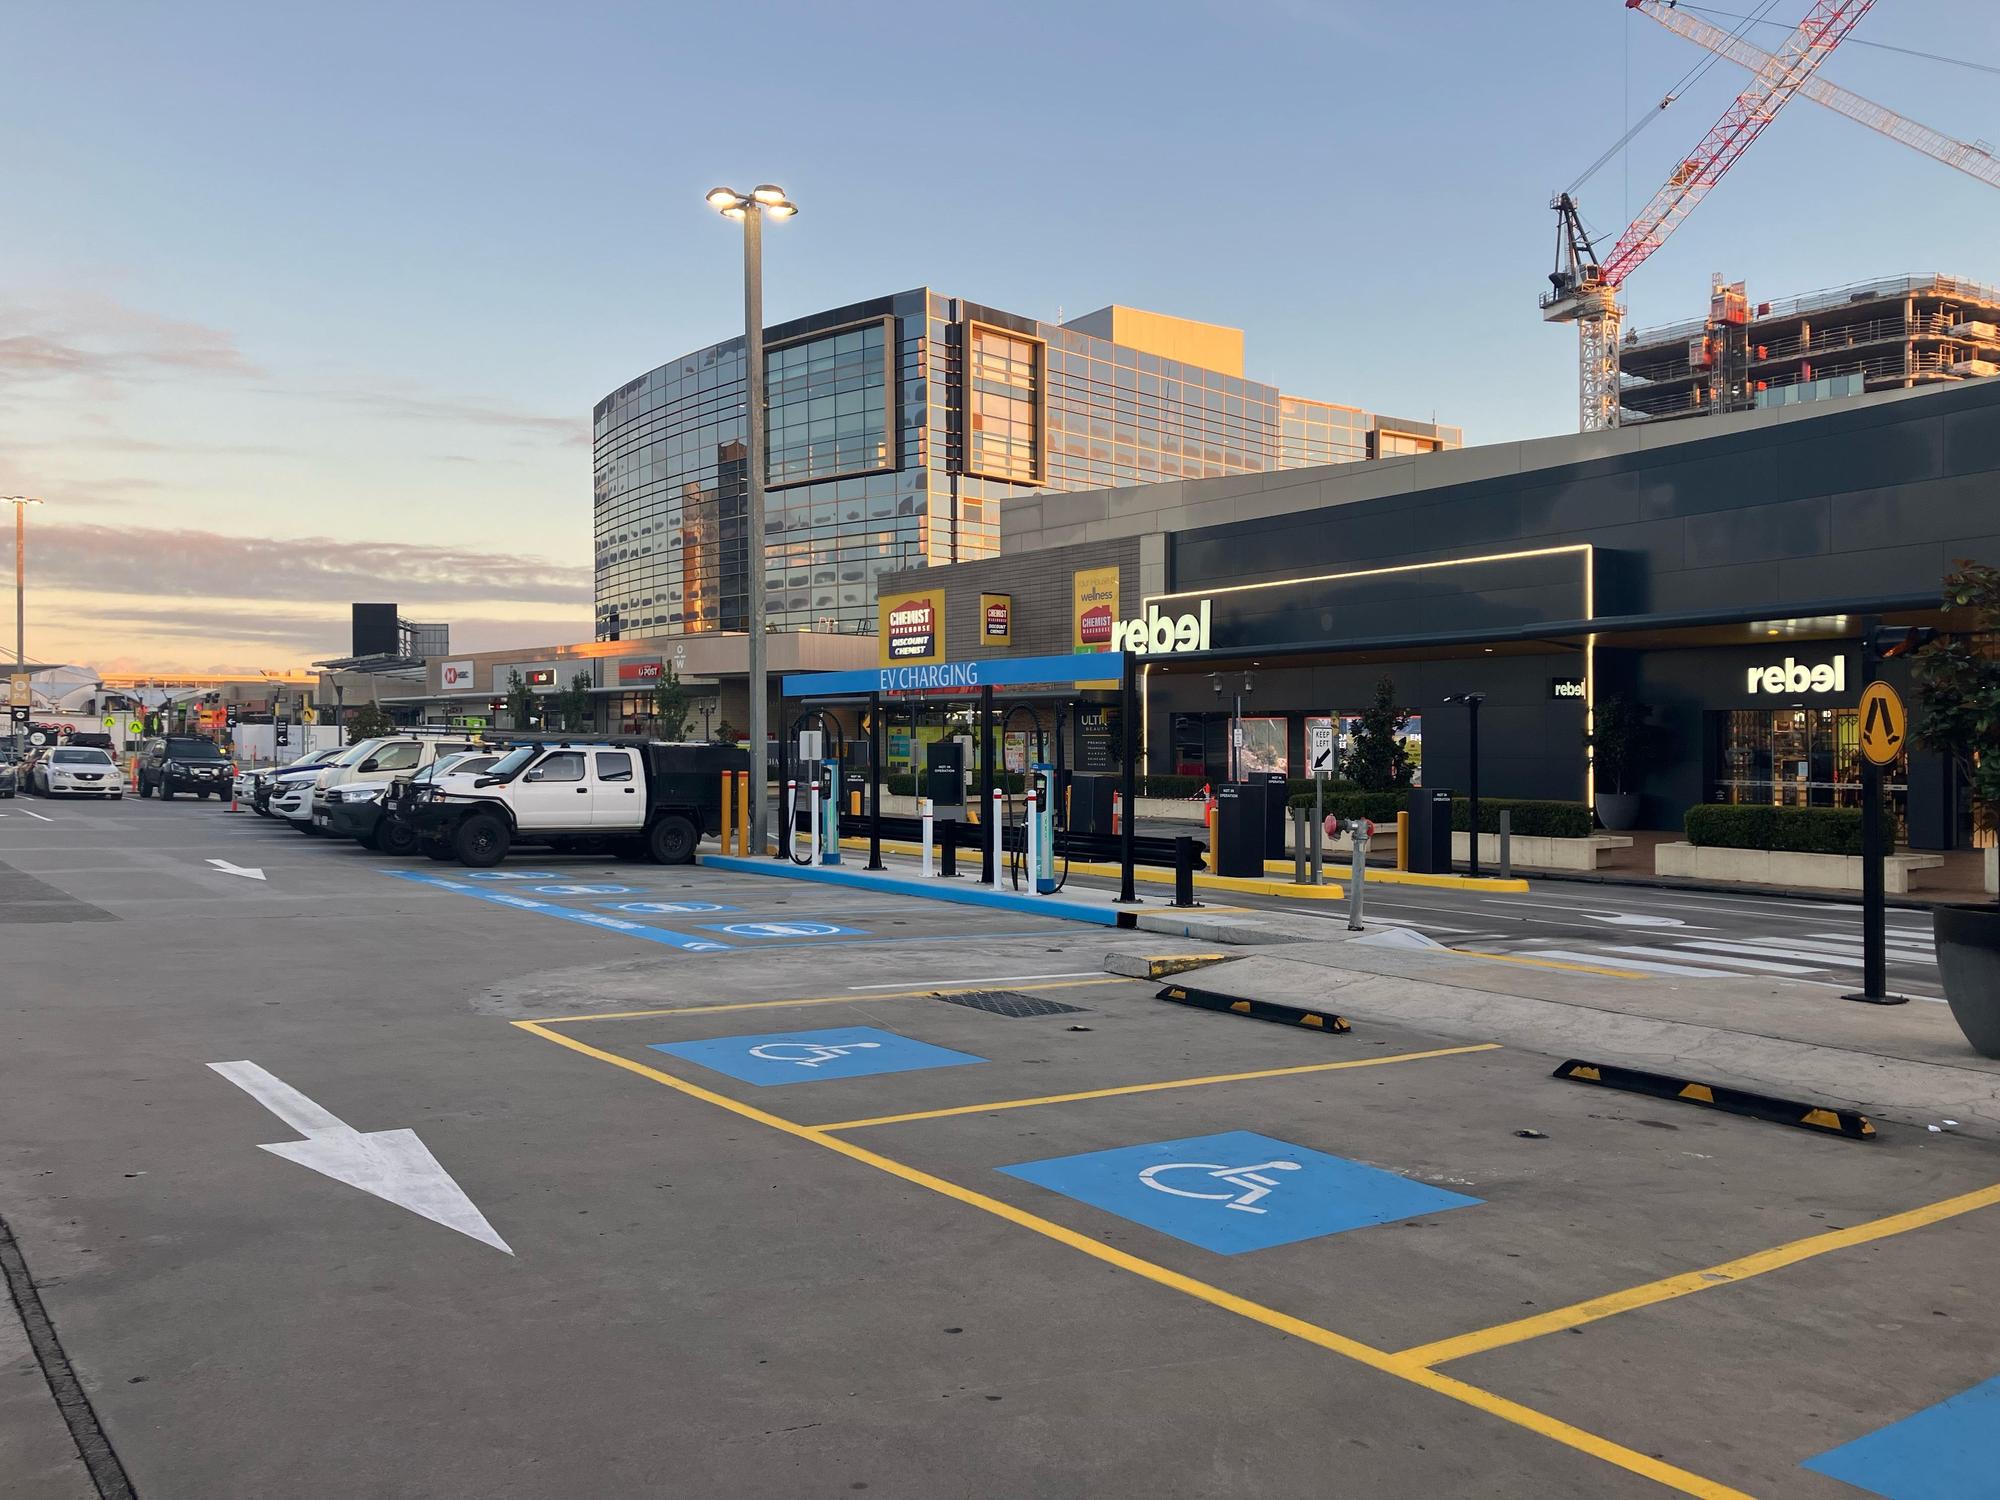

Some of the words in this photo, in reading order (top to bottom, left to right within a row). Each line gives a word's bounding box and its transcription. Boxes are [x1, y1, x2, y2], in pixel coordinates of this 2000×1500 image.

[1081, 587, 1113, 602] wellness
[889, 608, 931, 627] CHEMIST
[1082, 616, 1111, 627] CHEMIST
[890, 625, 931, 634] WAREHOUSE
[1111, 599, 1211, 655] rebel
[892, 636, 930, 647] DISCOUNT
[894, 646, 926, 655] CHEMIST
[880, 669, 897, 690] EV
[899, 662, 978, 688] CHARGING
[1747, 654, 1845, 694] rebel
[1555, 681, 1585, 696] rebel
[1316, 731, 1330, 739] KEEP
